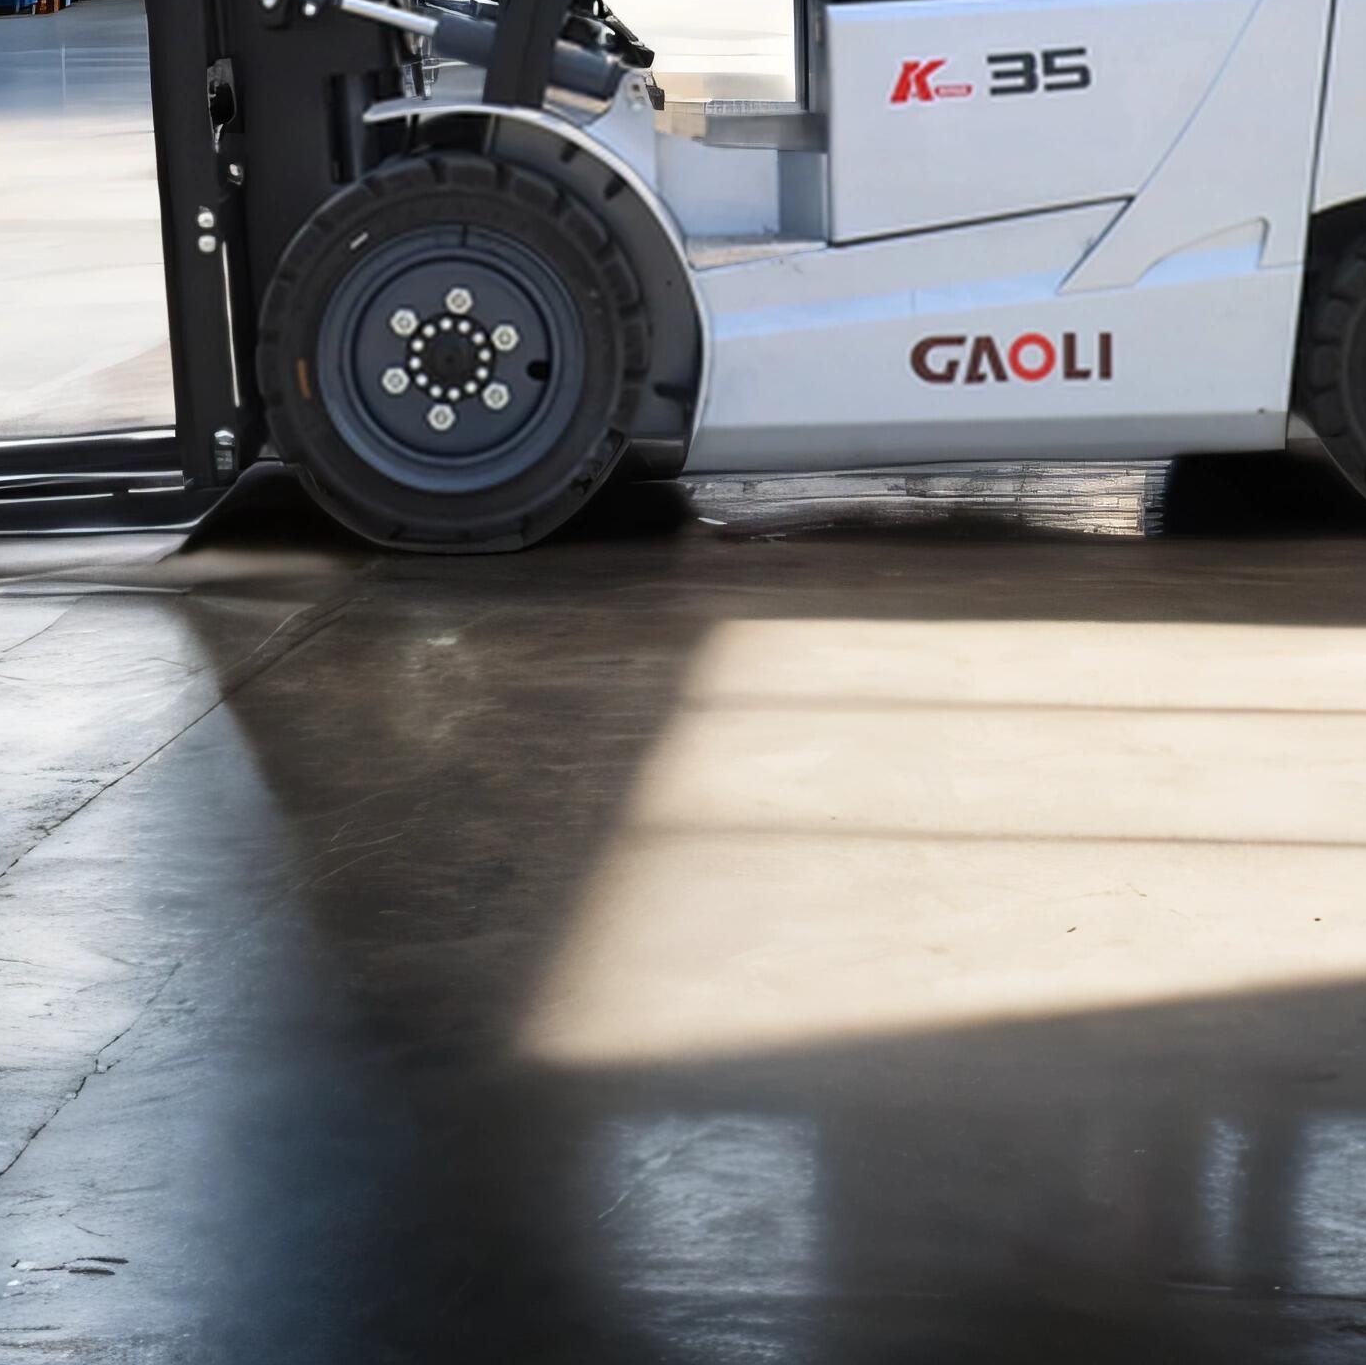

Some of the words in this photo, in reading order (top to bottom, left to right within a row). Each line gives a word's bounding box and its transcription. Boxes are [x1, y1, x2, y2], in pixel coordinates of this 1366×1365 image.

[890, 59, 947, 103] K
[987, 47, 1092, 96] 35
[910, 332, 1113, 384] GAOLI
